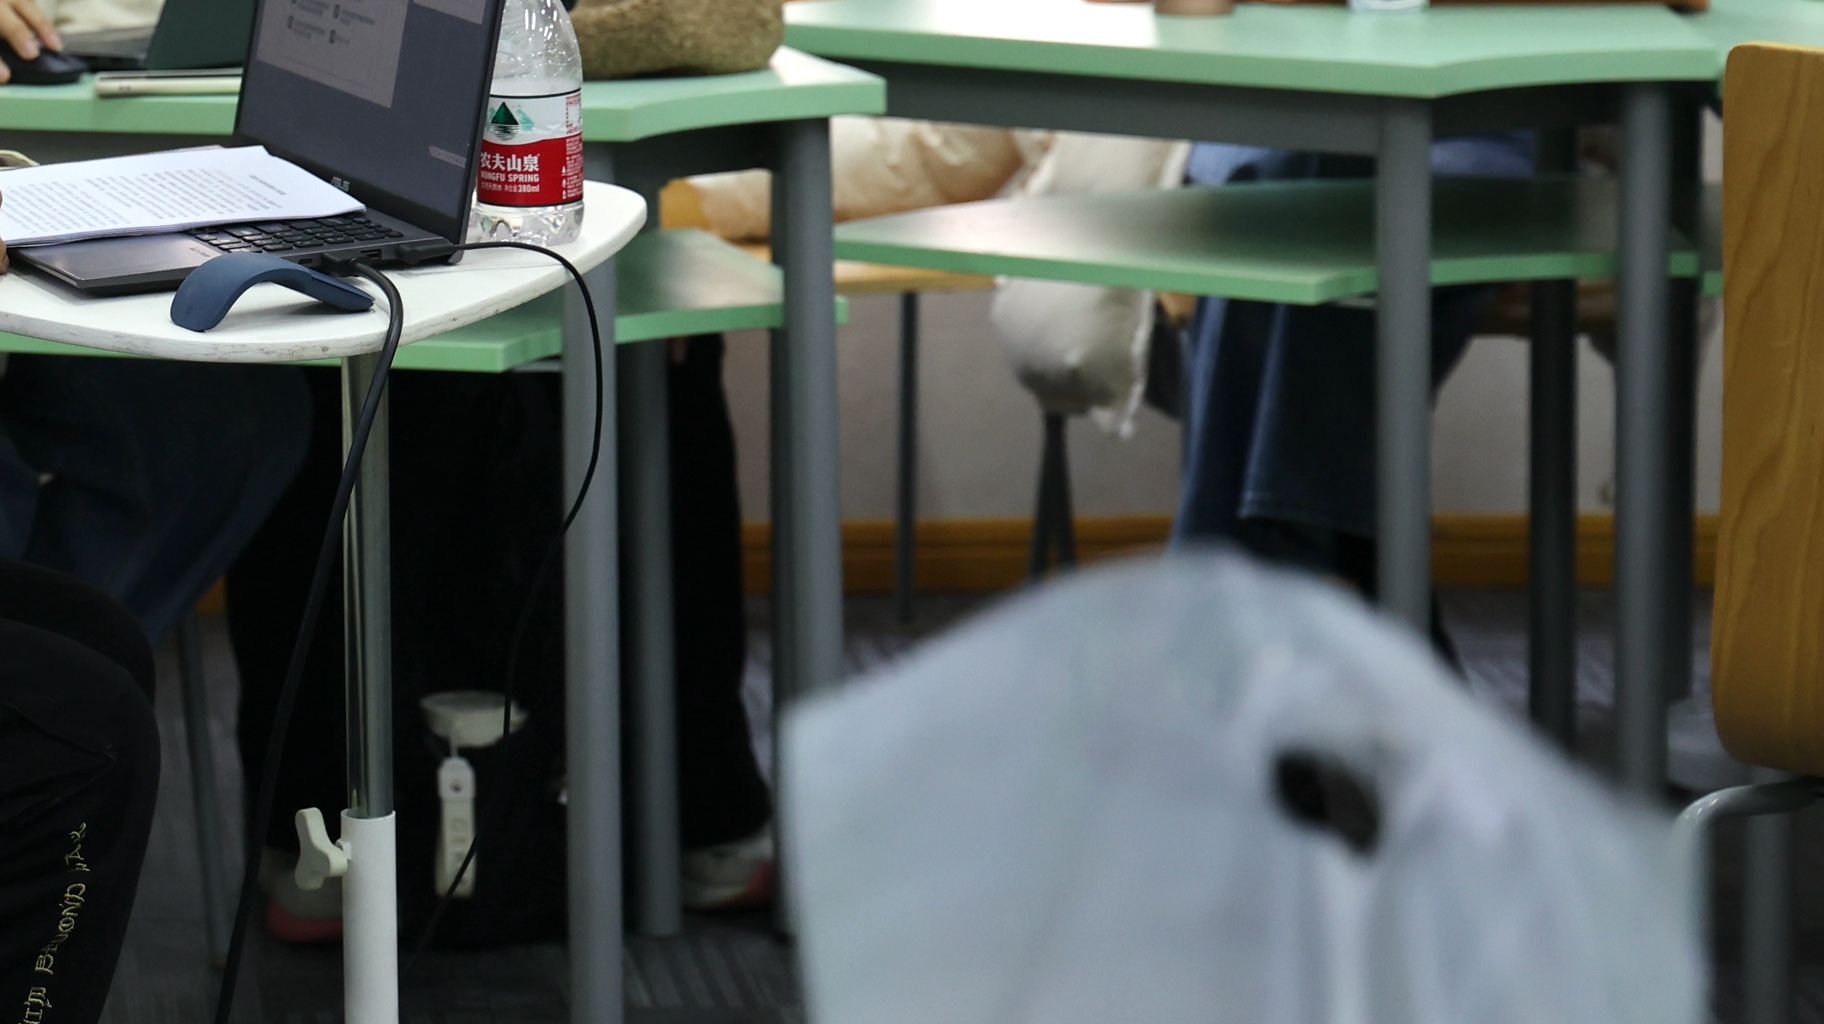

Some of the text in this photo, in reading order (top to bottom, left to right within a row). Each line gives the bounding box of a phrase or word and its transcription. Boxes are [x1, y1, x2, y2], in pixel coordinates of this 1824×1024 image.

[480, 152, 539, 172] 农夫山泉
[508, 173, 539, 183] SPRING
